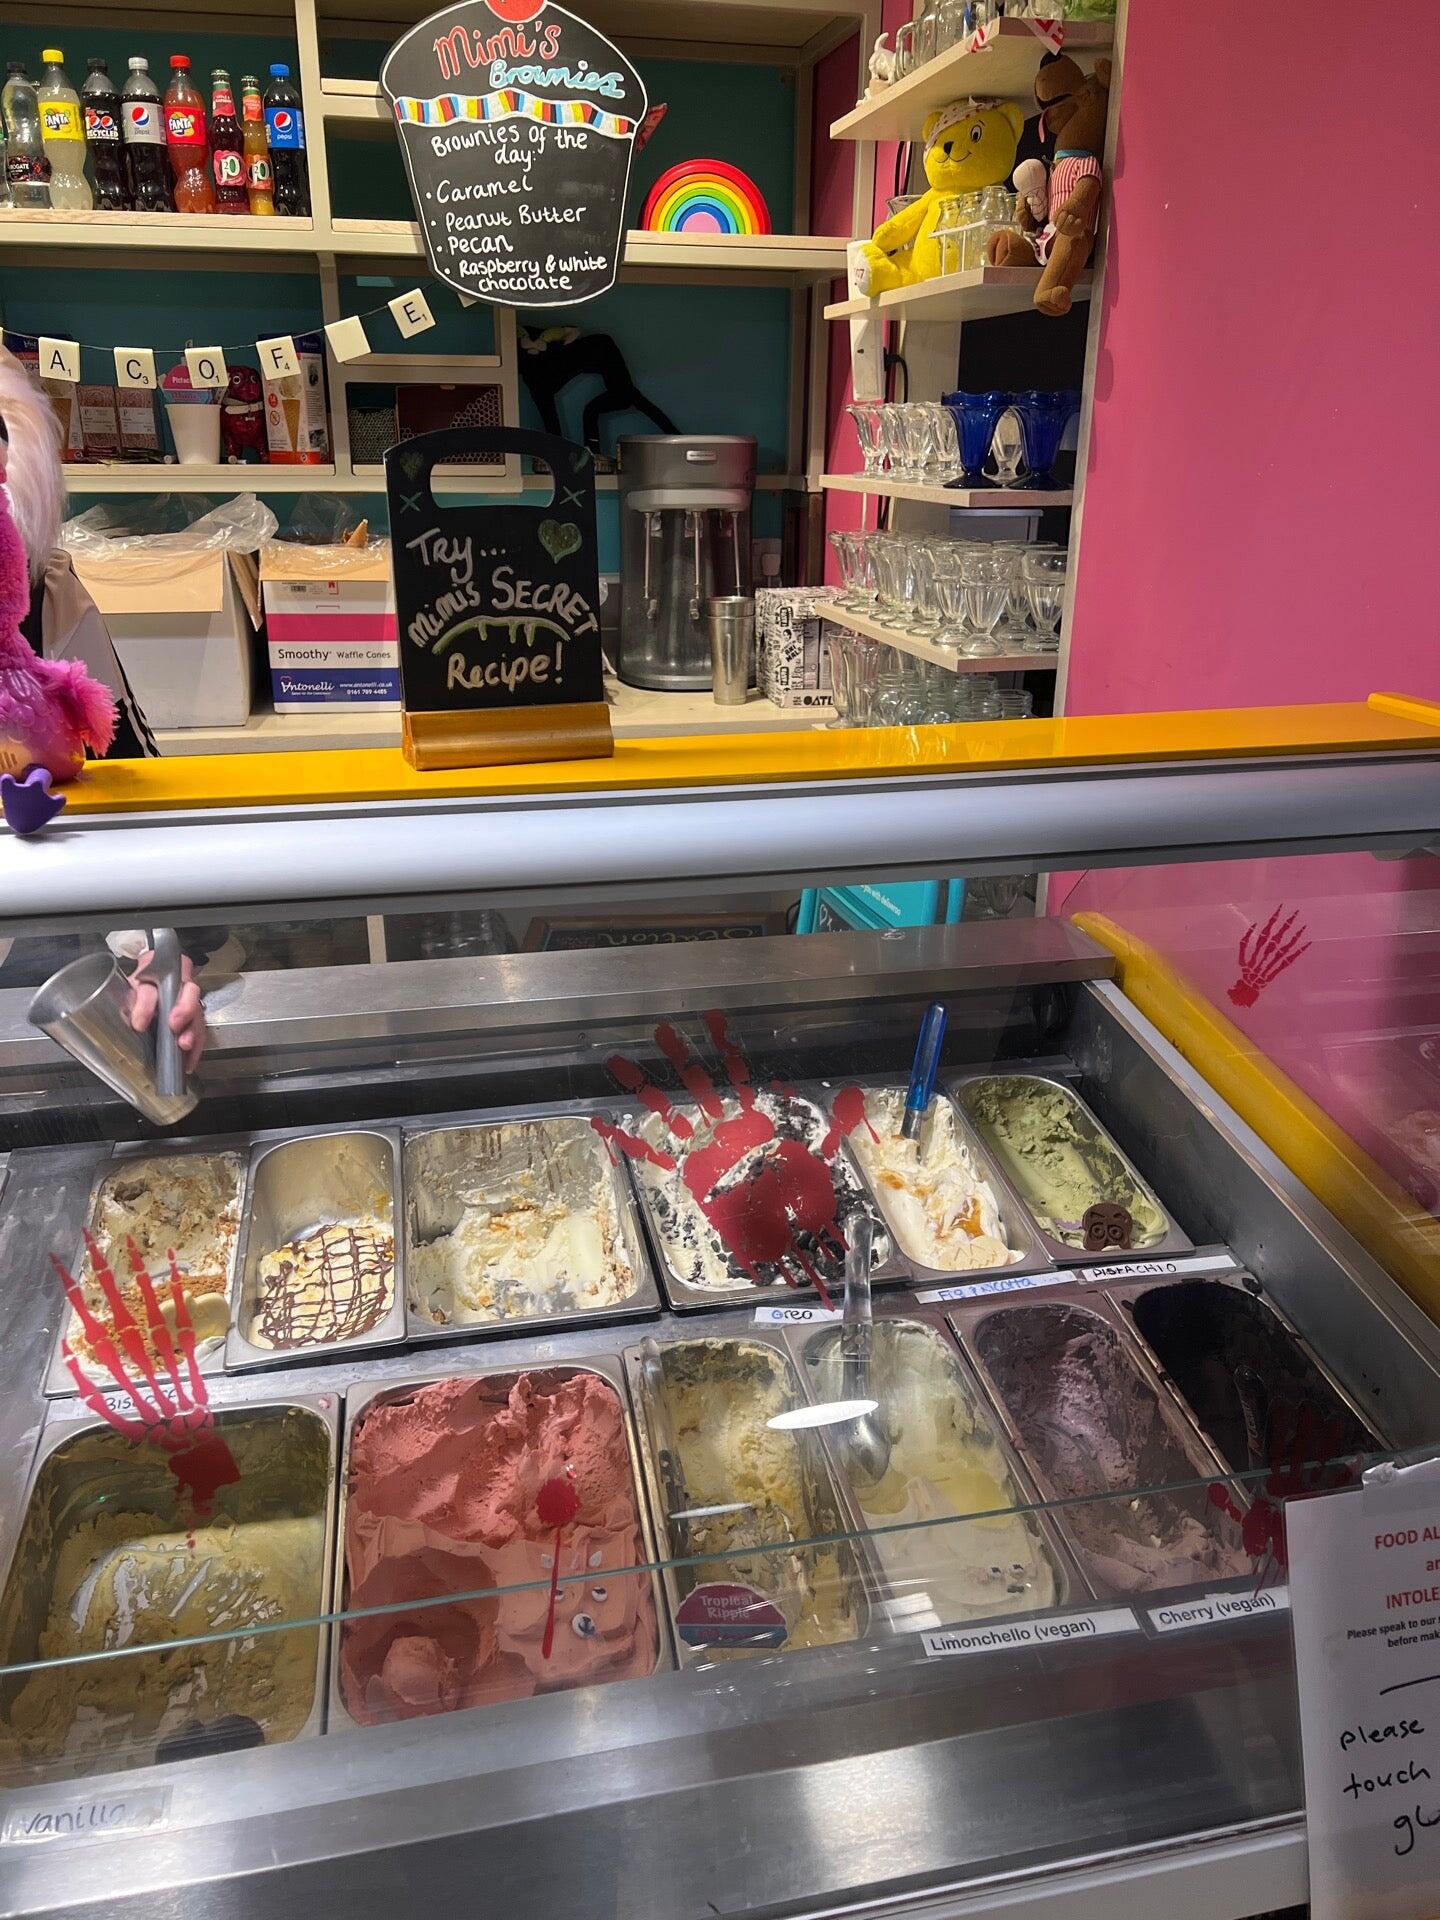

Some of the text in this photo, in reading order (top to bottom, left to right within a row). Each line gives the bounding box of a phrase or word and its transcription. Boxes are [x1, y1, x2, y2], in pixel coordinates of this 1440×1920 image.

[433, 21, 562, 80] Mimi's
[489, 59, 626, 99] Brownies
[431, 124, 520, 157] Brownies
[554, 129, 588, 151] the
[436, 175, 533, 203] Caramel
[445, 205, 586, 233] Peanut Butter
[459, 257, 541, 279] Raspberry
[478, 274, 573, 292] chocolate
[278, 649, 391, 661] Smoothy Waffle Cones
[281, 681, 335, 693] Antonelli
[1375, 1530, 1418, 1550] FOOD
[700, 1594, 754, 1608] Tropical
[1159, 1593, 1277, 1627] Cherry (vegan)
[930, 1616, 1097, 1652] Limonchello (vegan)
[1347, 1627, 1377, 1640] Please
[1379, 1621, 1406, 1635] speak
[1408, 1619, 1418, 1629] to
[1420, 1616, 1436, 1626] our
[1388, 1634, 1418, 1648] before
[1340, 1719, 1425, 1751] please
[1343, 1760, 1431, 1799] touch
